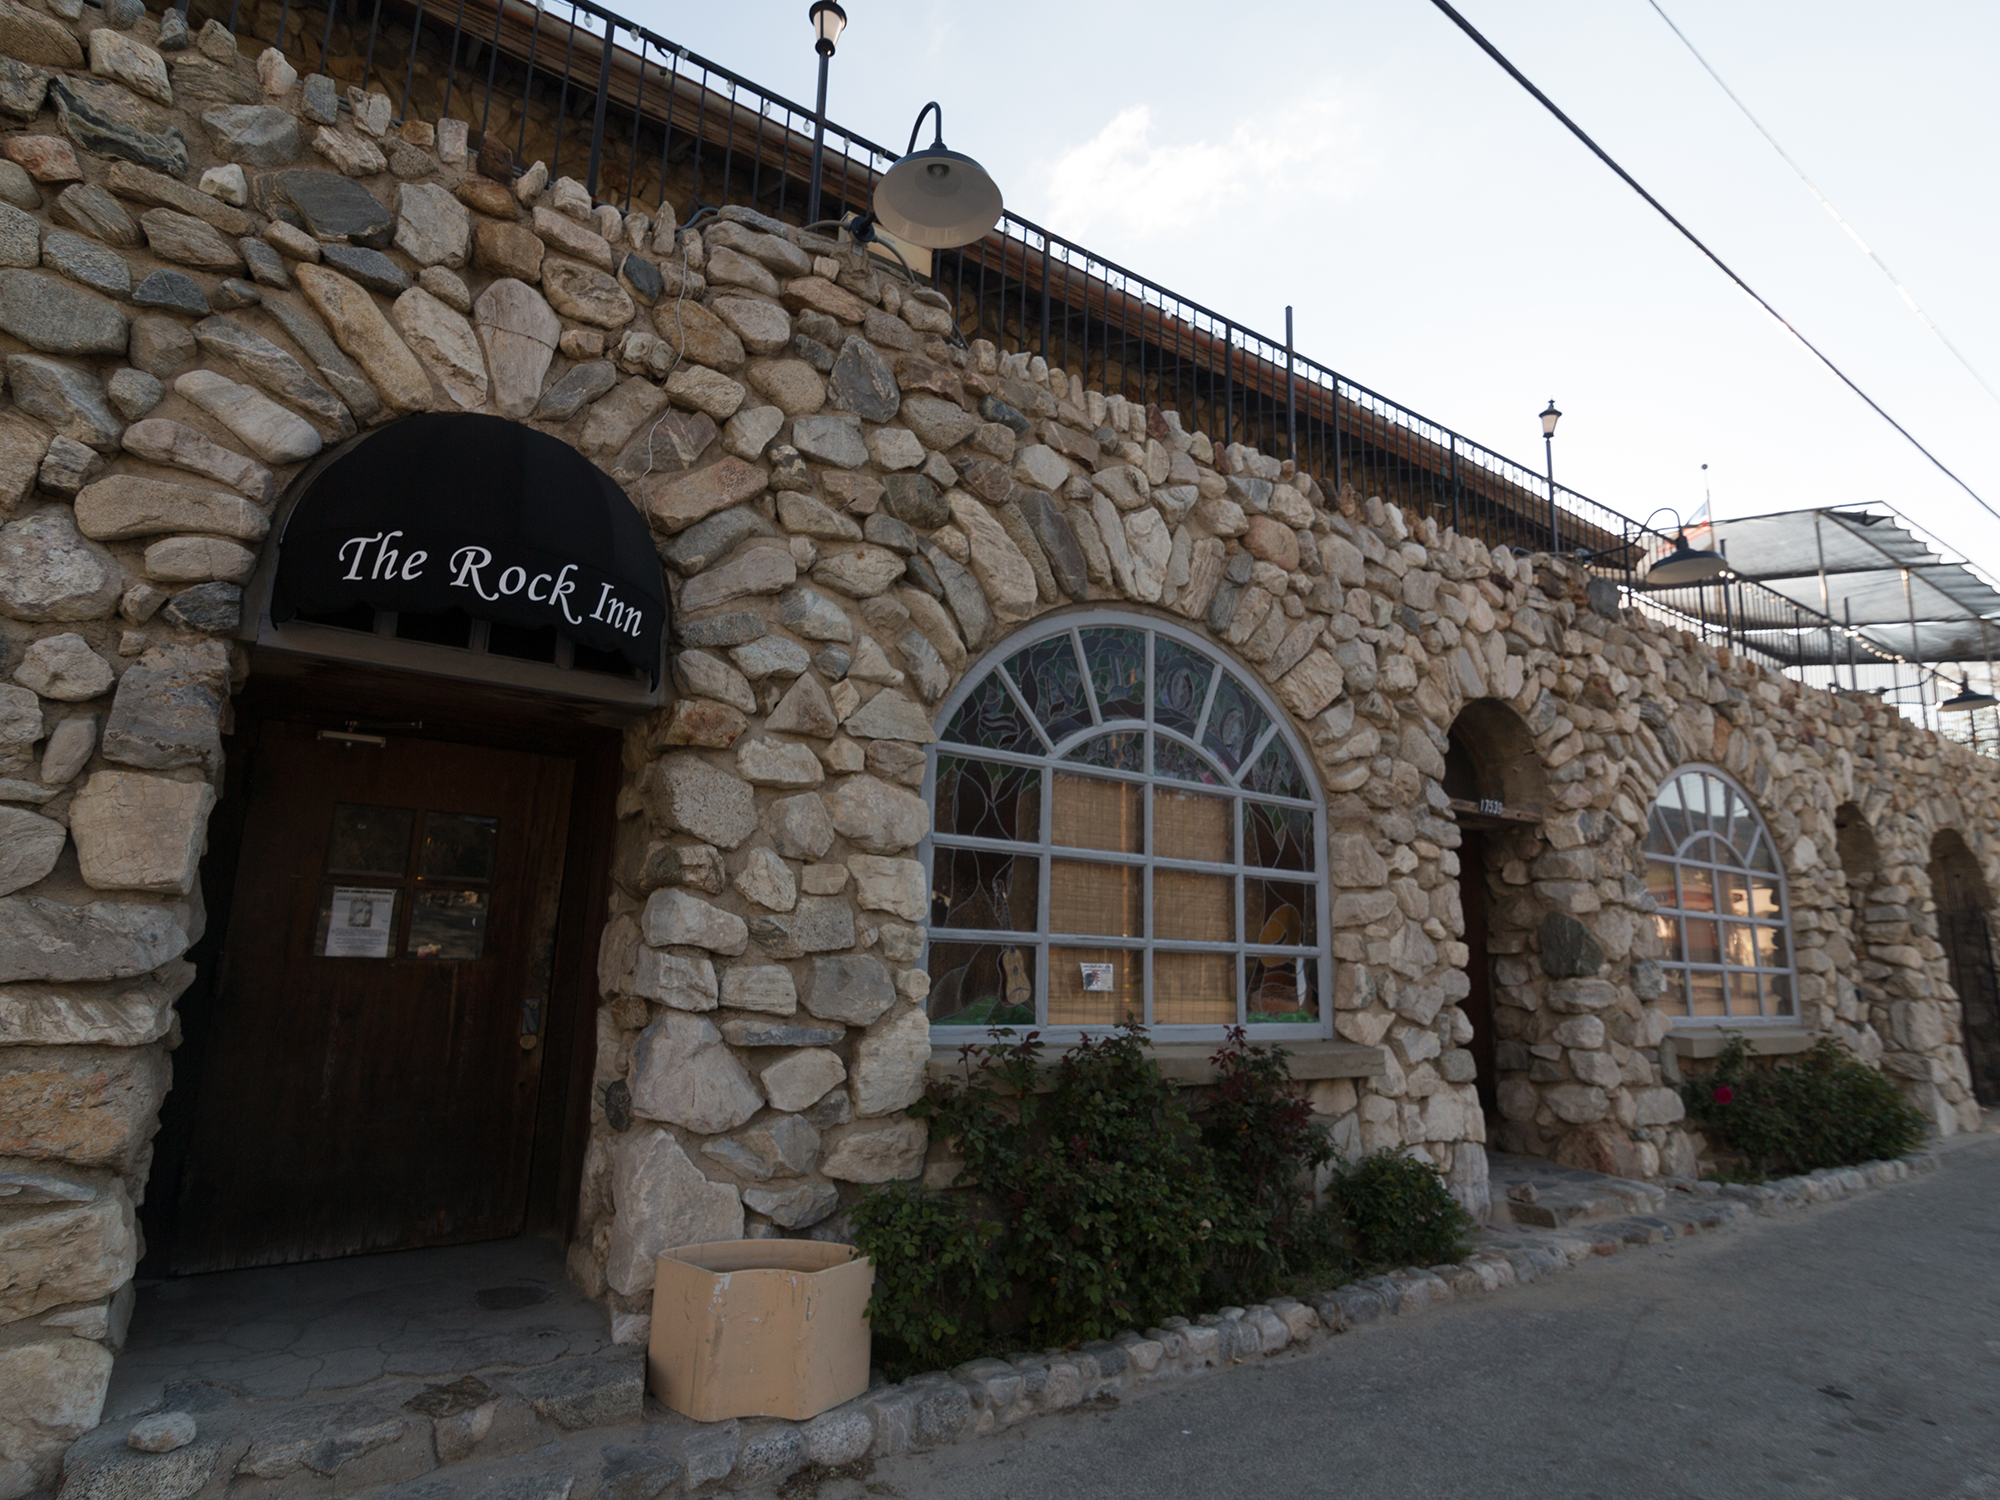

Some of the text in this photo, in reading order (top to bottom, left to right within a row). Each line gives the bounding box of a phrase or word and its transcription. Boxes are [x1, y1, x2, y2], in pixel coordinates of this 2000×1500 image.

[338, 530, 643, 638] The Rock Inn
